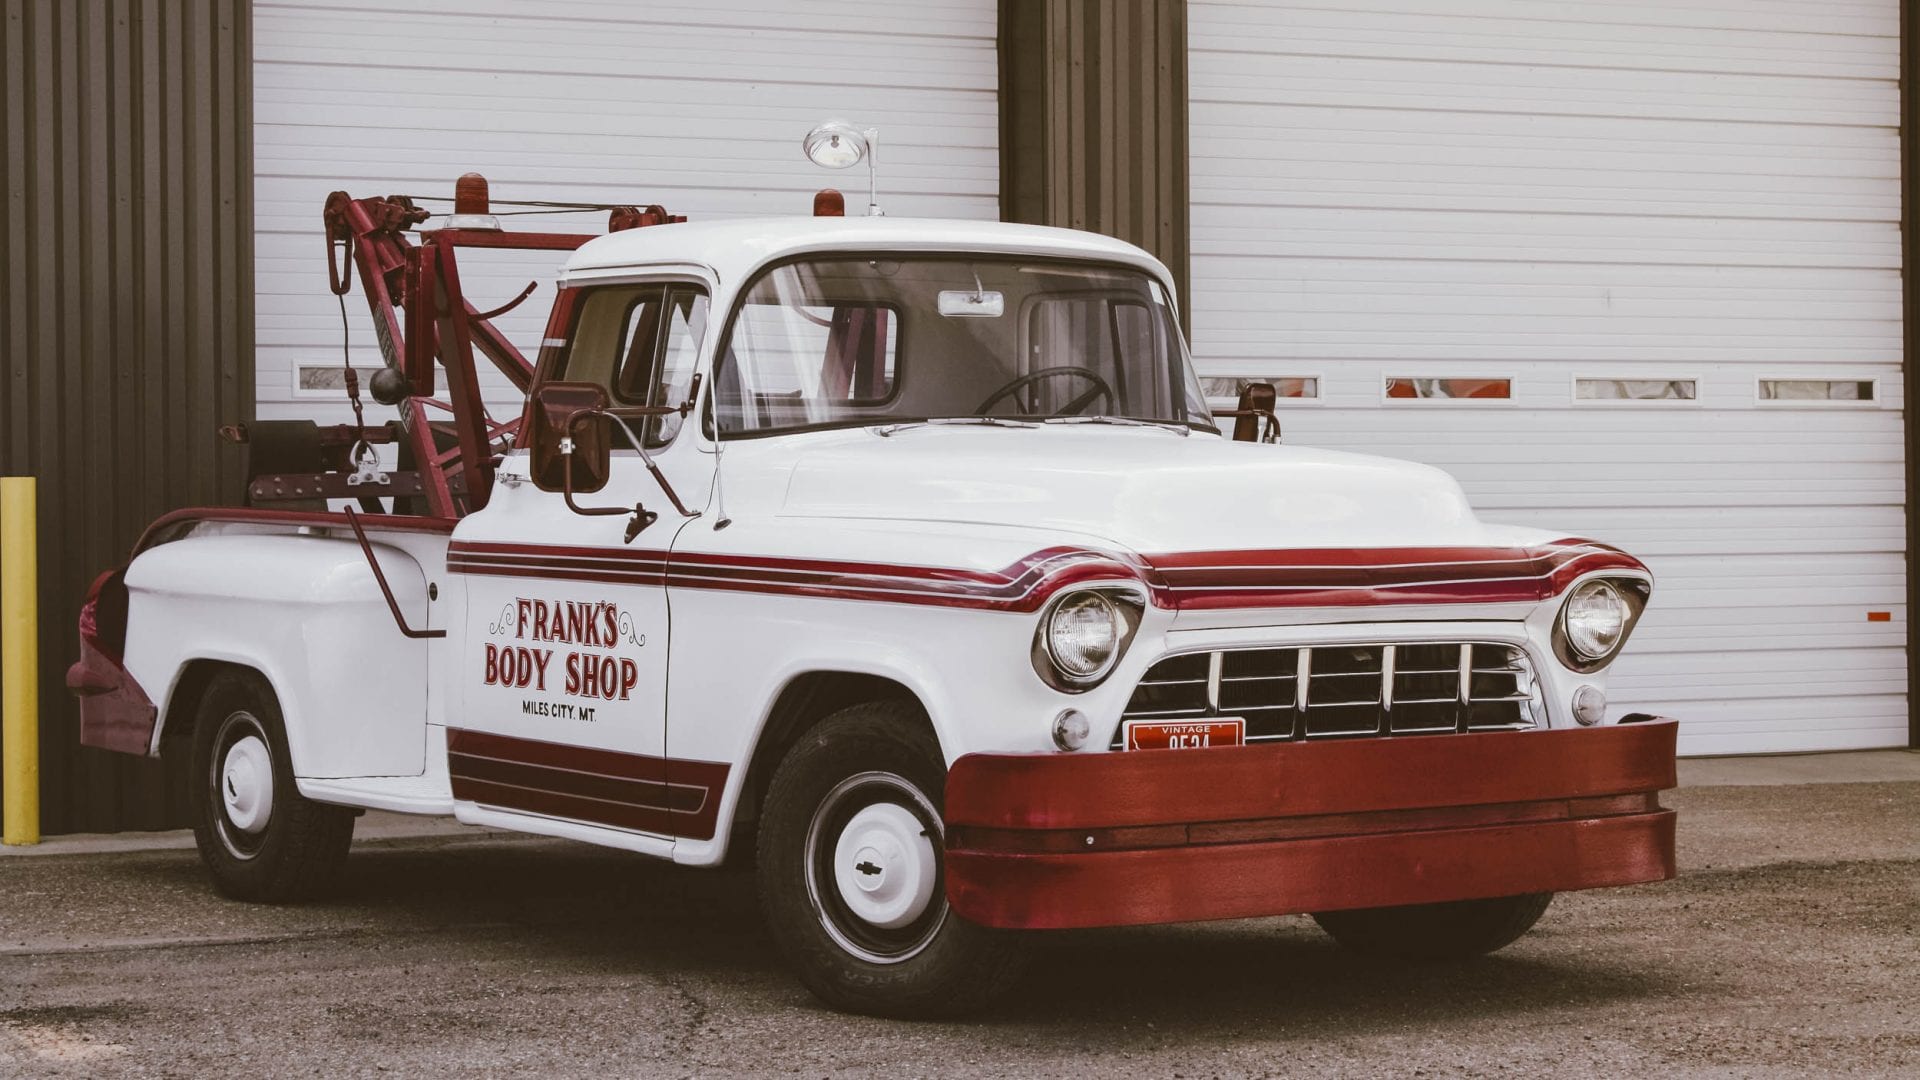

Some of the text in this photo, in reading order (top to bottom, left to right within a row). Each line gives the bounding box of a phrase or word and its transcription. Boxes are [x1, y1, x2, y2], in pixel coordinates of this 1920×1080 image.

[515, 597, 619, 649] FRANK'S
[483, 643, 638, 701] BODY SHOP
[522, 700, 549, 717] MILES
[1162, 725, 1211, 734] VINTAGE
